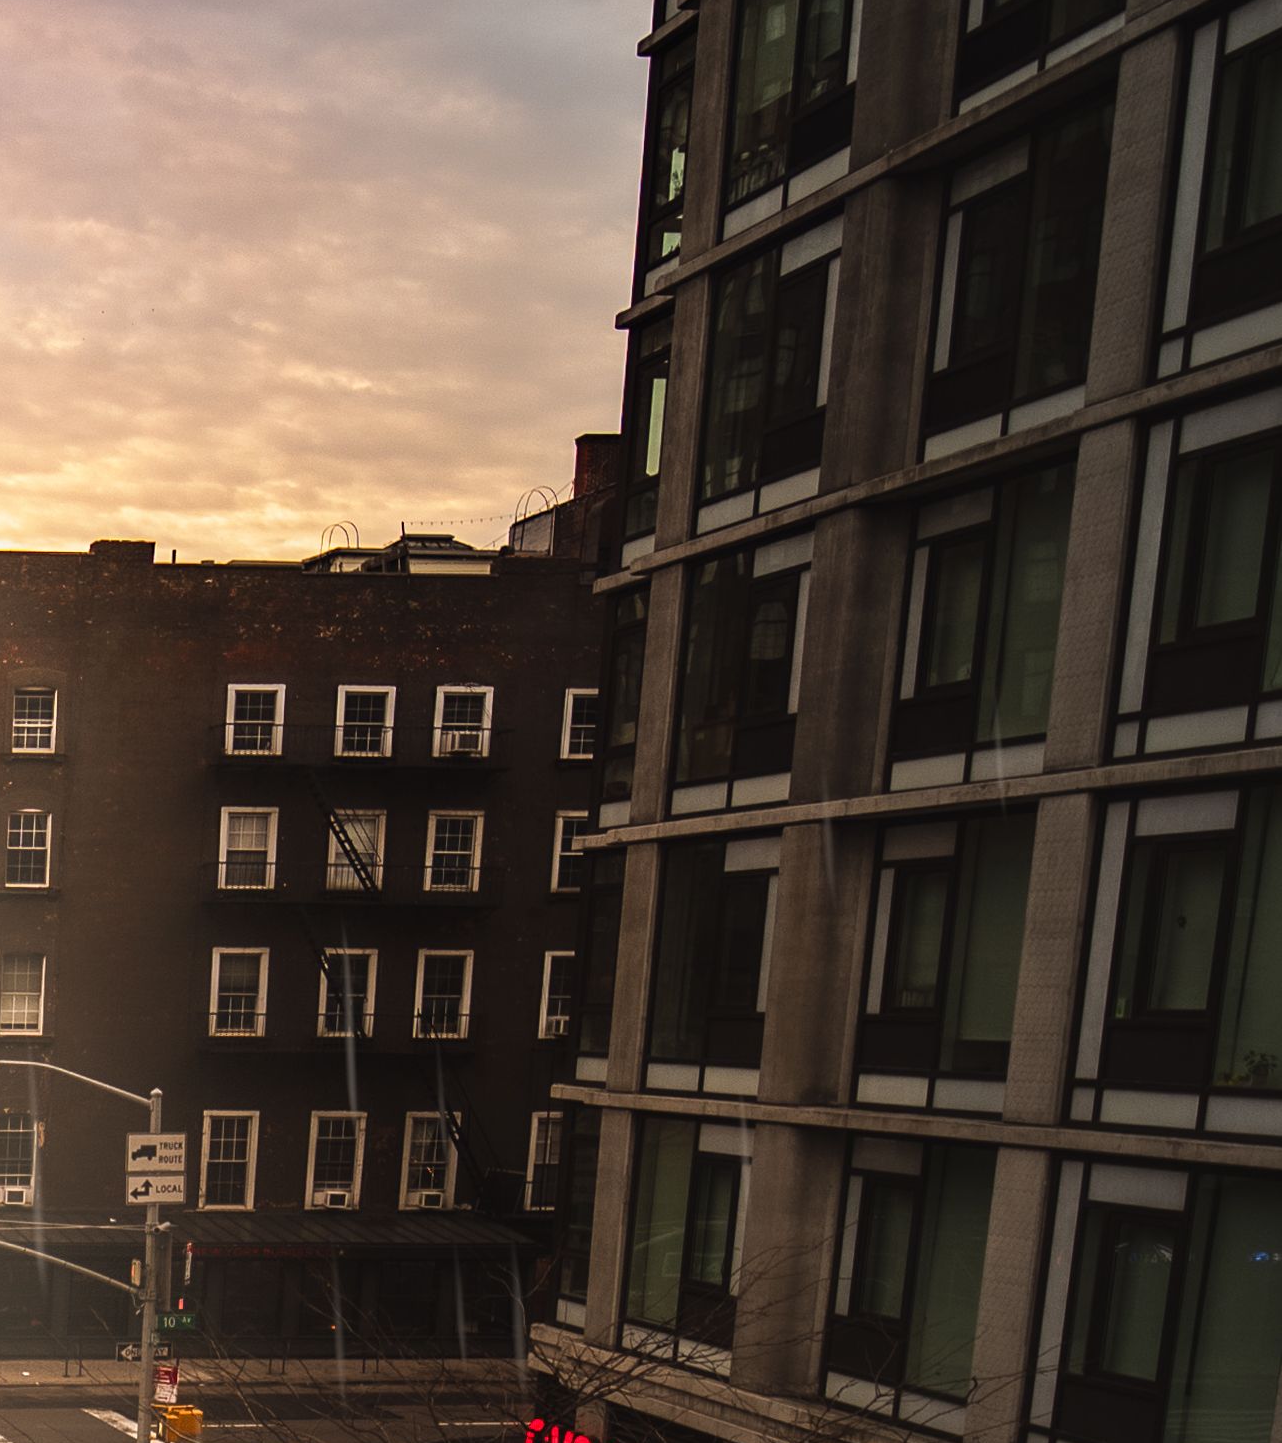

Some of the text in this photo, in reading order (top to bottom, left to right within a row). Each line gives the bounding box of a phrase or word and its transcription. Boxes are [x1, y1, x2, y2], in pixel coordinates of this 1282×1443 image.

[159, 1142, 183, 1151] TRUCK
[158, 1155, 183, 1164] ROUTE
[155, 1184, 183, 1194] LOCAL
[164, 1316, 176, 1328] 10
